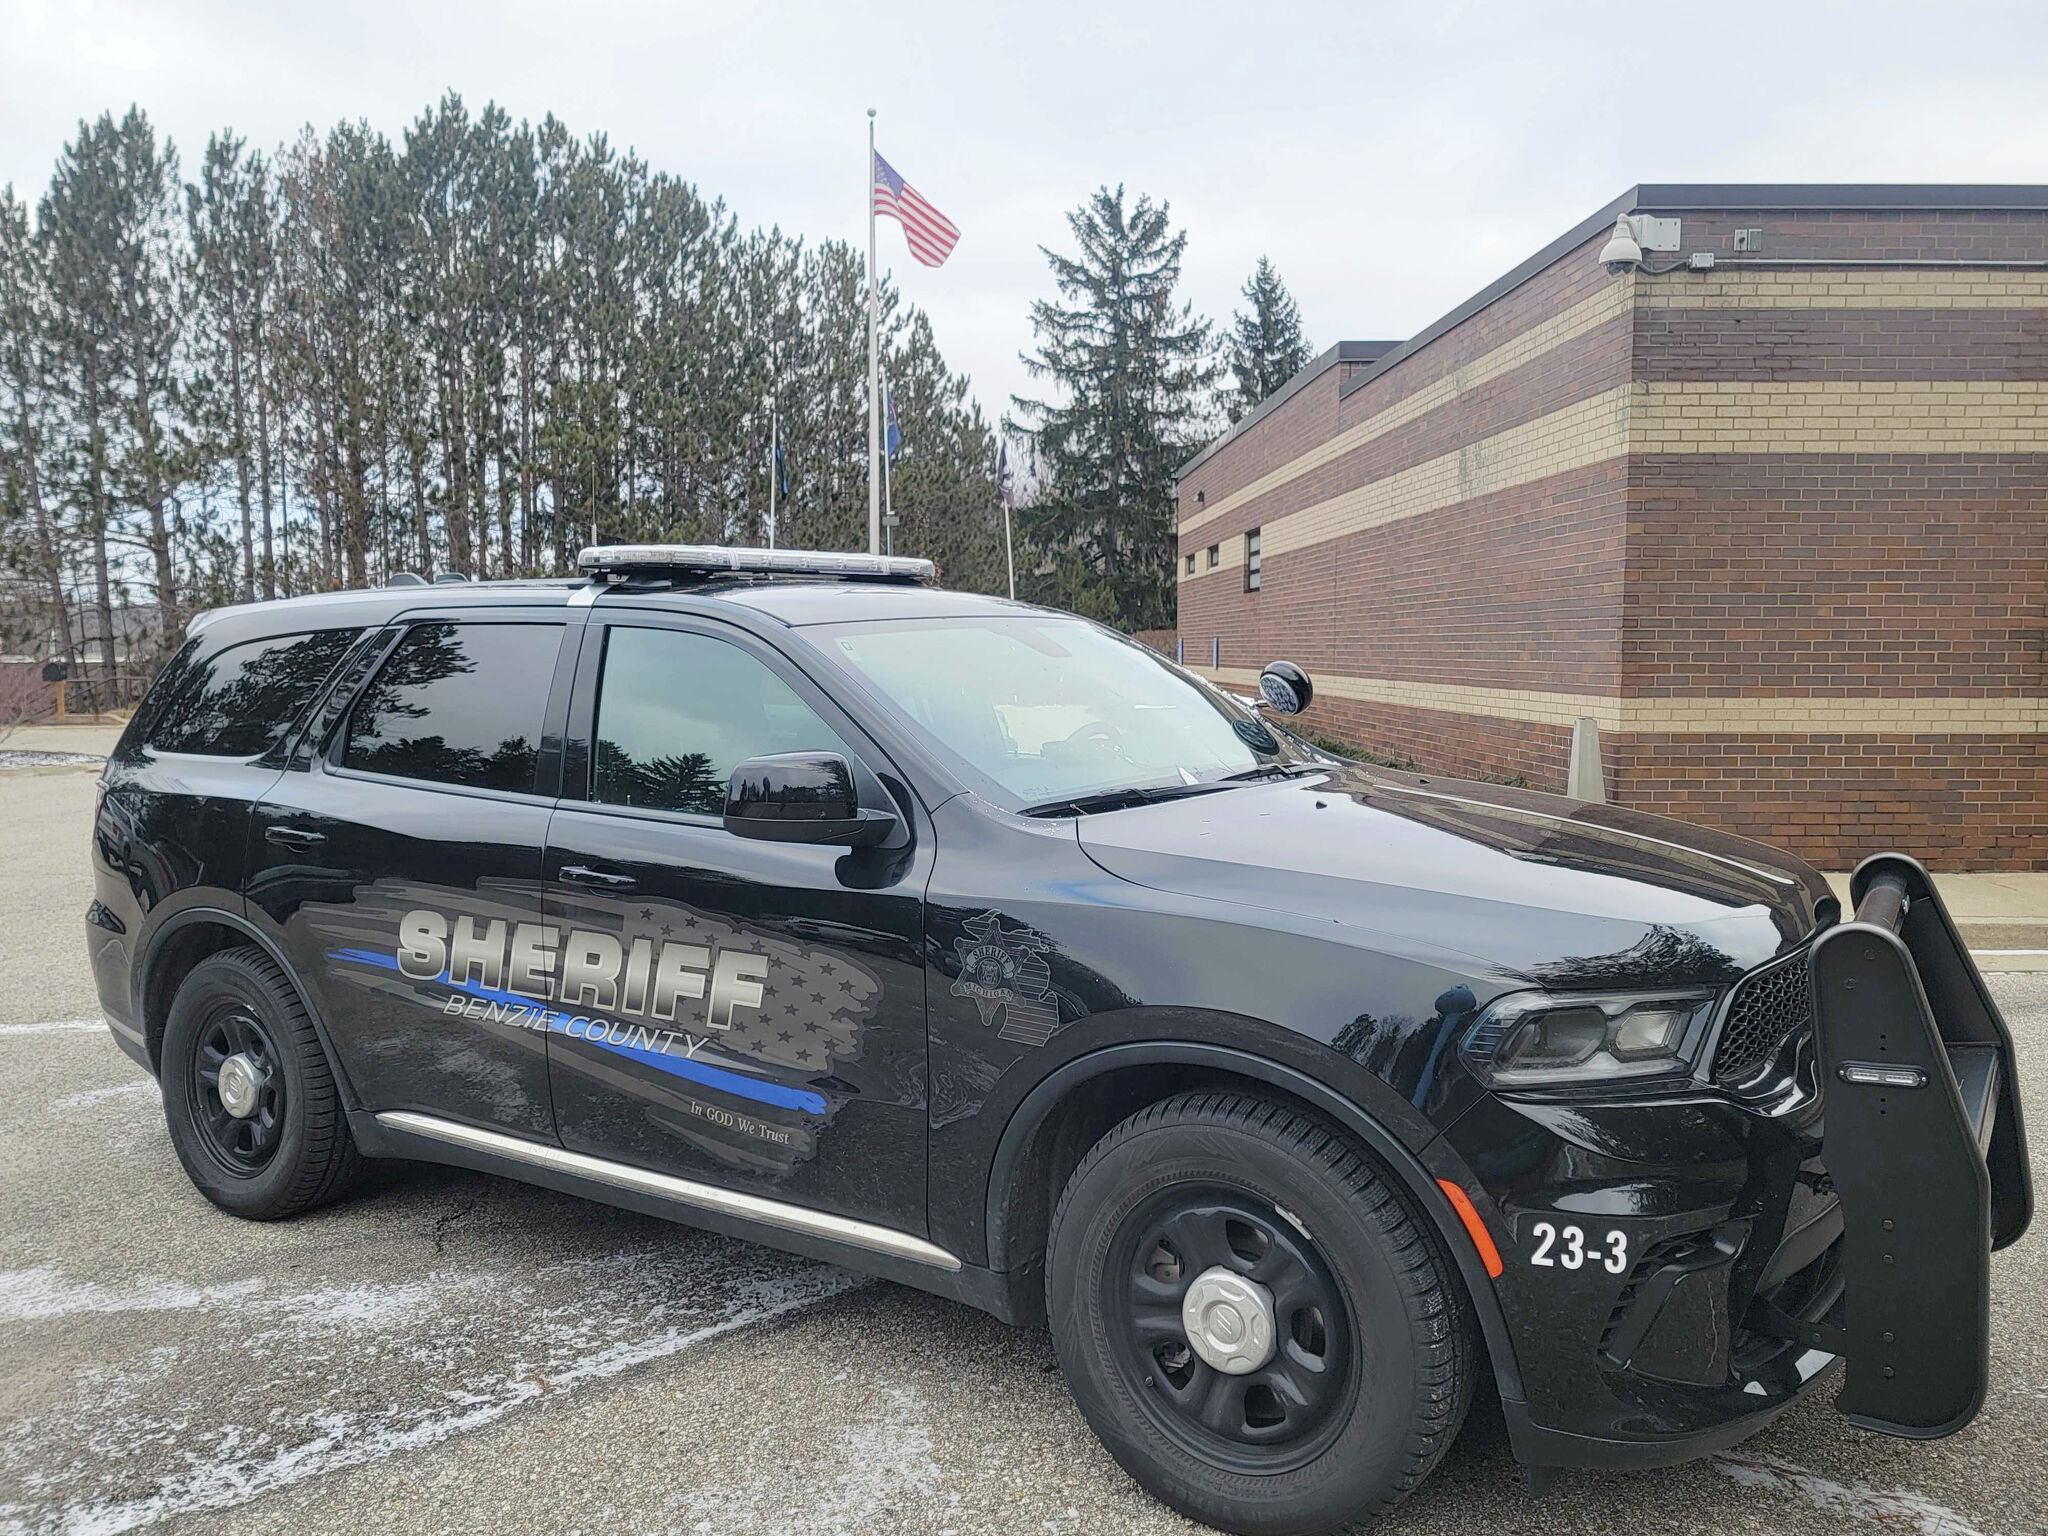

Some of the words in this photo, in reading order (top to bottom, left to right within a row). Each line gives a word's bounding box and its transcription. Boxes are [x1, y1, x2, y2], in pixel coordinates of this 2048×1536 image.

[397, 909, 770, 1031] SHERIFF
[972, 946, 1011, 964] SHERIFF
[964, 983, 1012, 998] MICHIGAN
[443, 994, 560, 1032] BENZIE
[564, 1015, 710, 1059] COUNTY
[690, 1101, 702, 1116] In
[706, 1107, 734, 1127] GOD
[738, 1117, 756, 1135] We
[758, 1124, 790, 1145] Trust
[1530, 1221, 1628, 1274] 23-3
